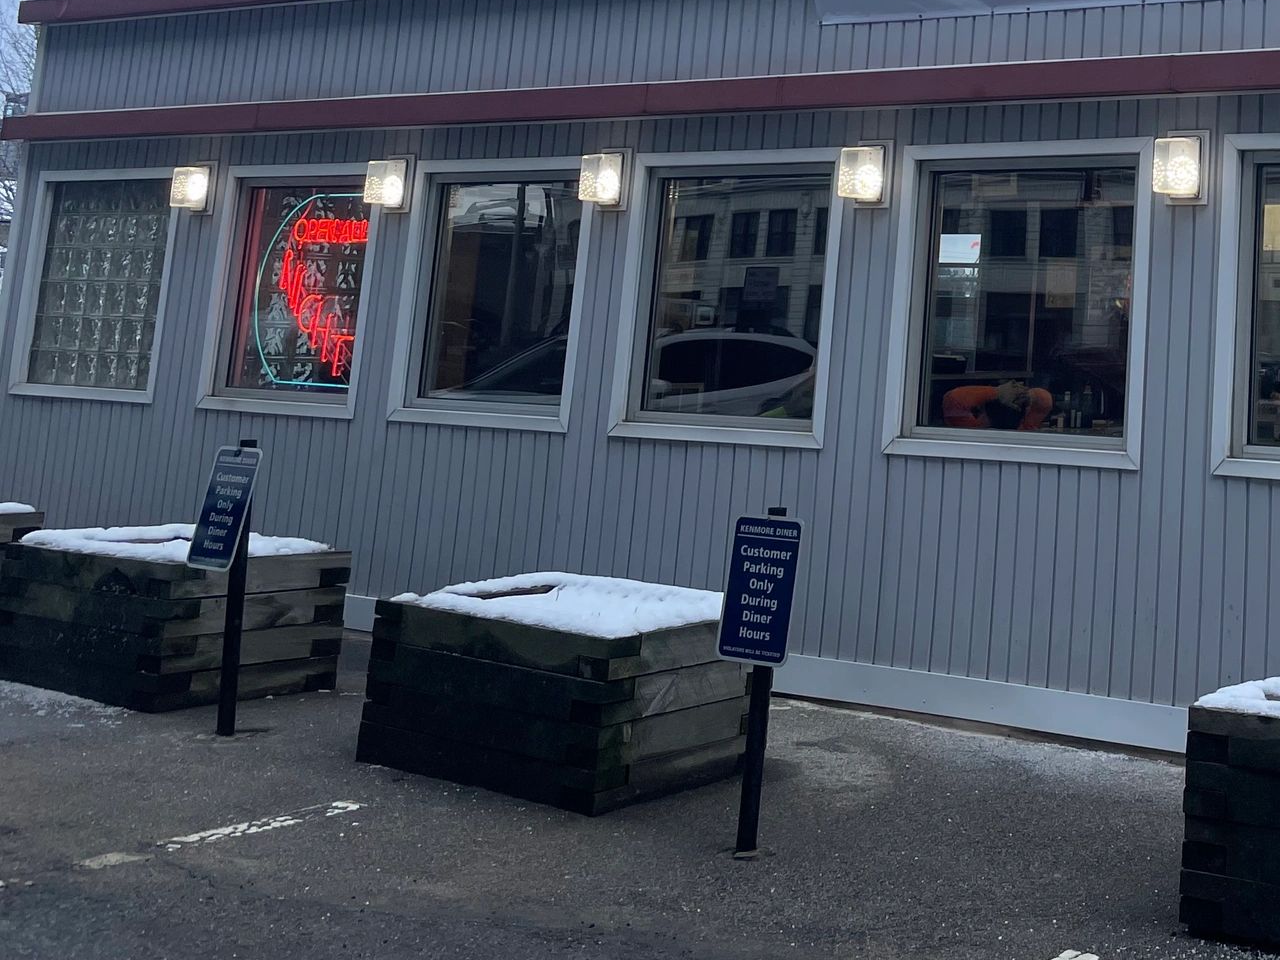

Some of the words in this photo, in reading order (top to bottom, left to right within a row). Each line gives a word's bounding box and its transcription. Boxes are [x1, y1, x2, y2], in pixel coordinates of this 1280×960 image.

[216, 472, 250, 484] Customer
[215, 486, 243, 499] Parking
[217, 500, 233, 512] Only
[209, 513, 233, 525] During
[207, 526, 228, 537] Diner
[740, 524, 774, 536] KENMORE
[776, 528, 798, 538] DINER
[203, 540, 224, 551] Hours
[740, 544, 792, 561] Customer
[743, 561, 785, 579] Parking
[749, 578, 774, 594] Only
[741, 594, 778, 611] During
[742, 610, 773, 624] Diner
[738, 626, 771, 641] Hours
